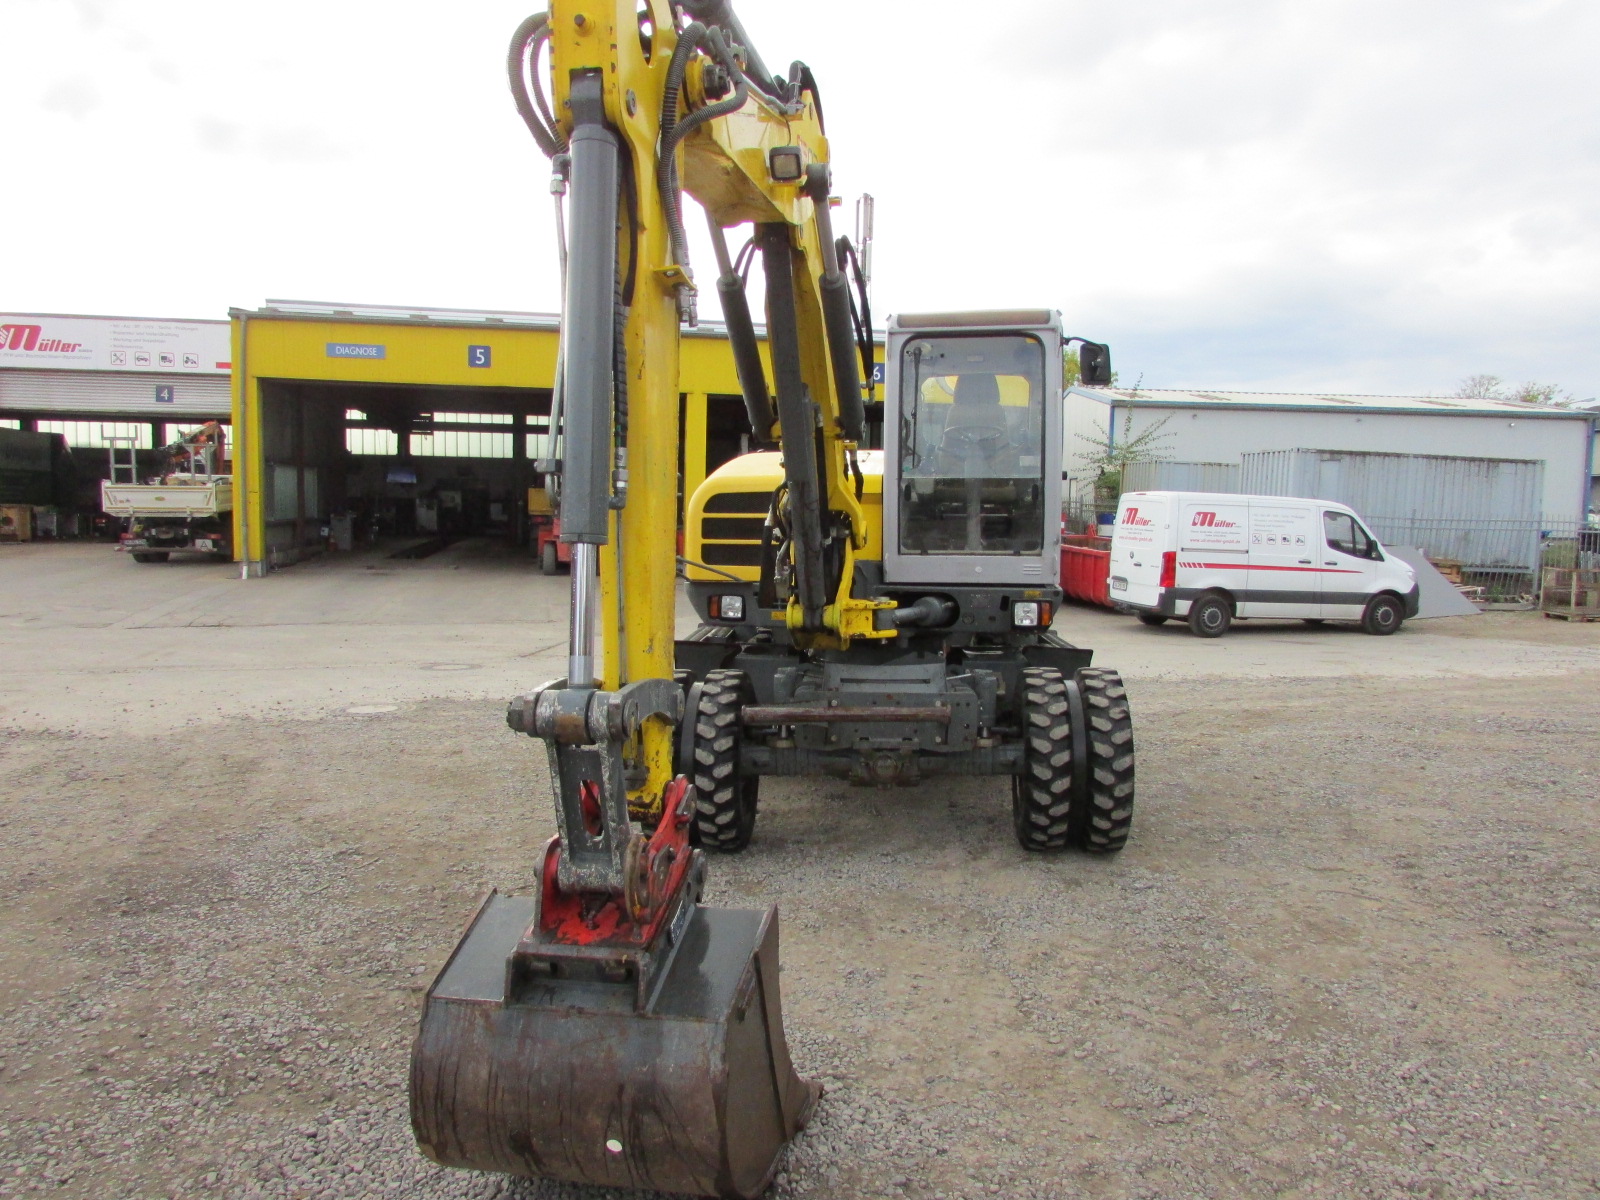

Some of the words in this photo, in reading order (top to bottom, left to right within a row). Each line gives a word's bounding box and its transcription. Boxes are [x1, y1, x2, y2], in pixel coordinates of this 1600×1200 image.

[0, 324, 82, 352] Müller
[335, 346, 378, 356] DIAGNOSE
[475, 349, 485, 364] 5
[873, 366, 881, 381] 6
[160, 388, 169, 401] 4
[1121, 507, 1152, 526] Müller
[1191, 511, 1237, 528] Müller
